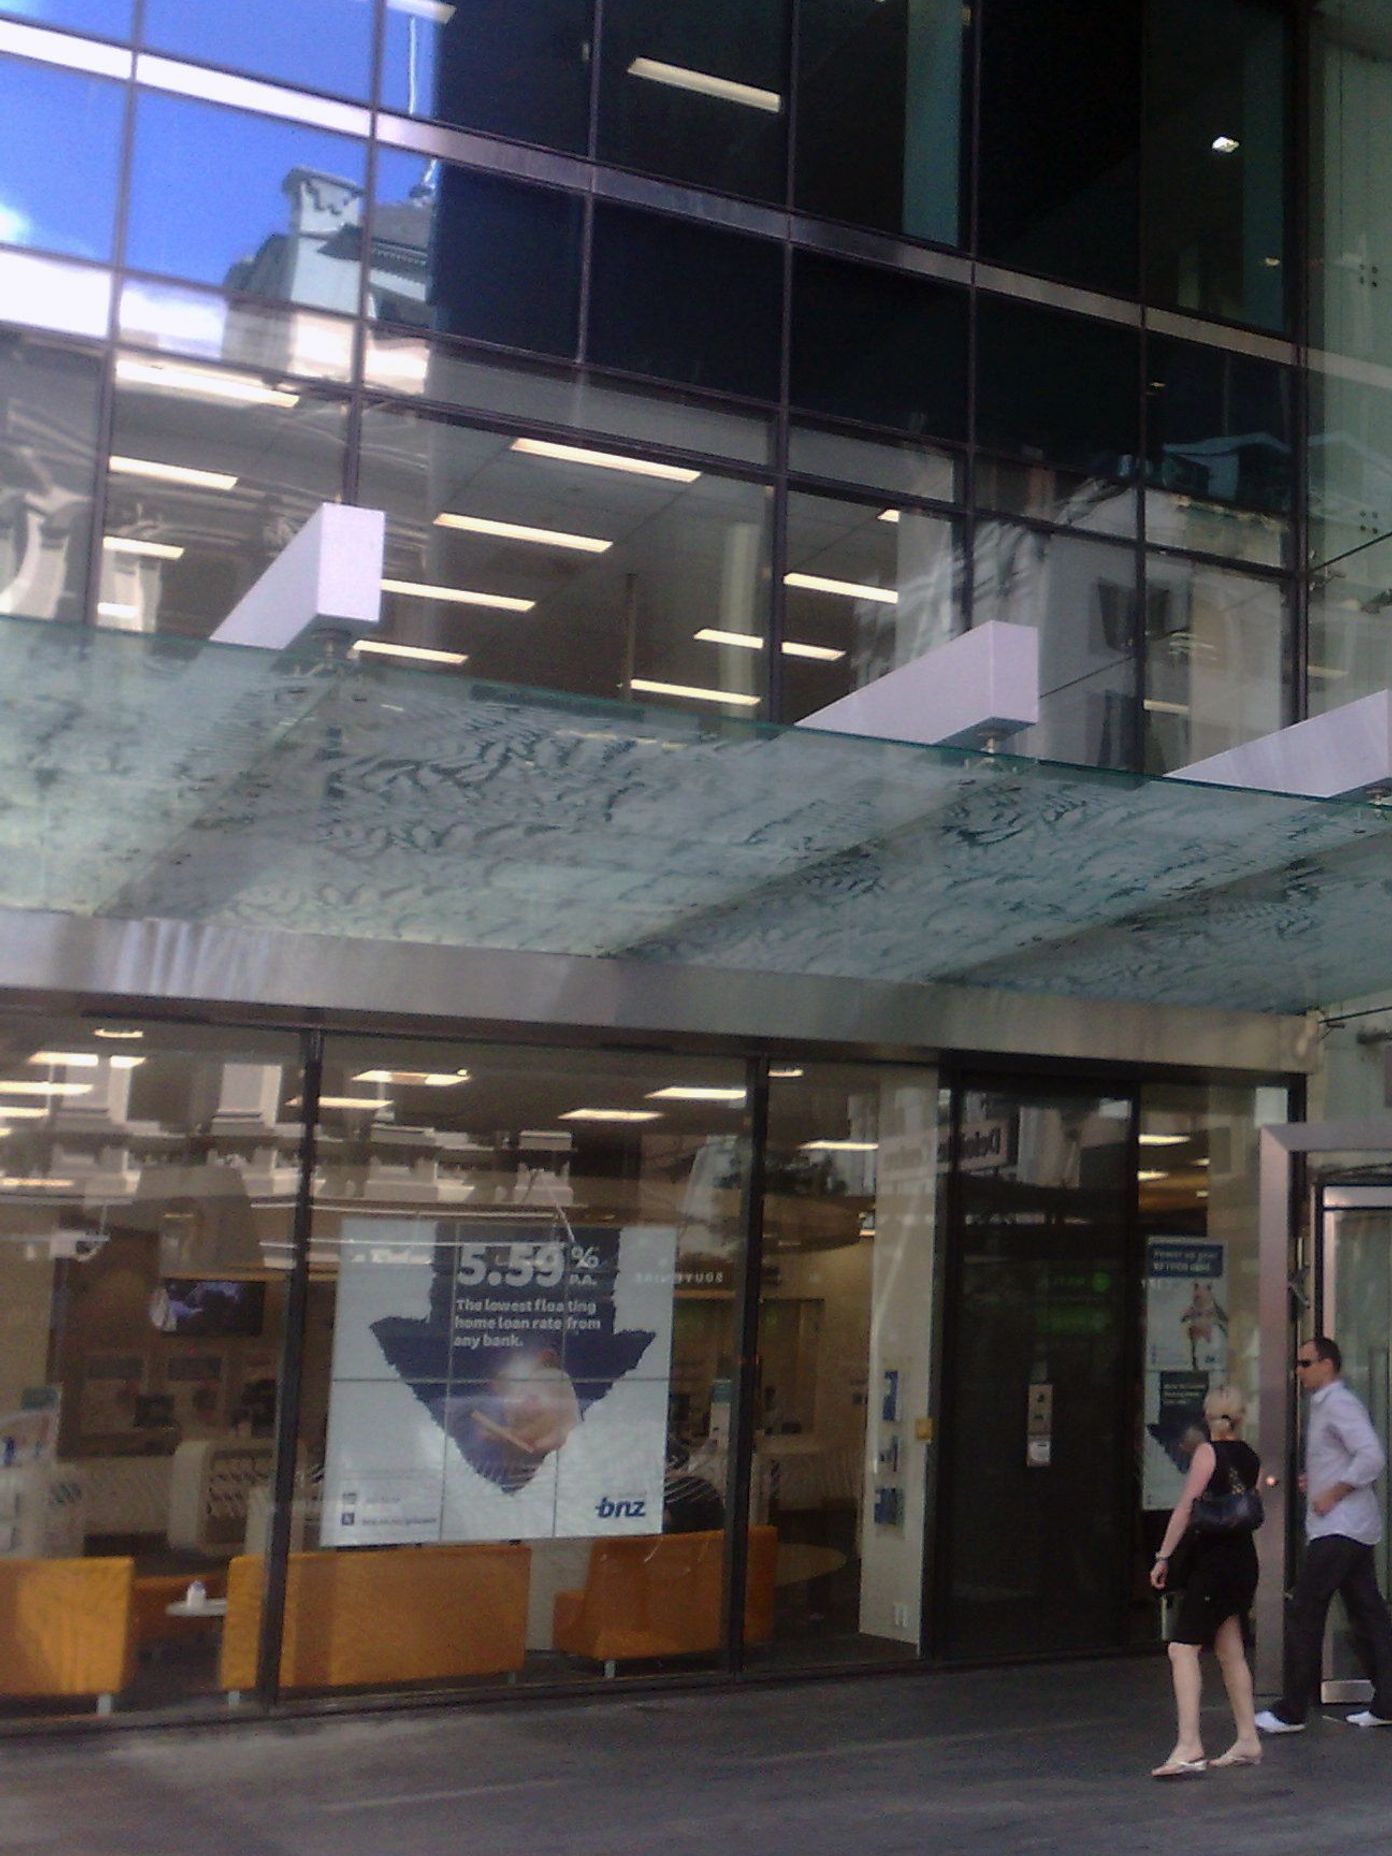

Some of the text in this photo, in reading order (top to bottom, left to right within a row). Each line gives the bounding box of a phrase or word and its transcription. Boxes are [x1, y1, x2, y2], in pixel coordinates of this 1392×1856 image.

[456, 1298, 597, 1315] The lowest floating
[455, 1316, 601, 1330] home loan rate from
[453, 1333, 524, 1349] any bank.
[595, 1497, 646, 1518] bnz
